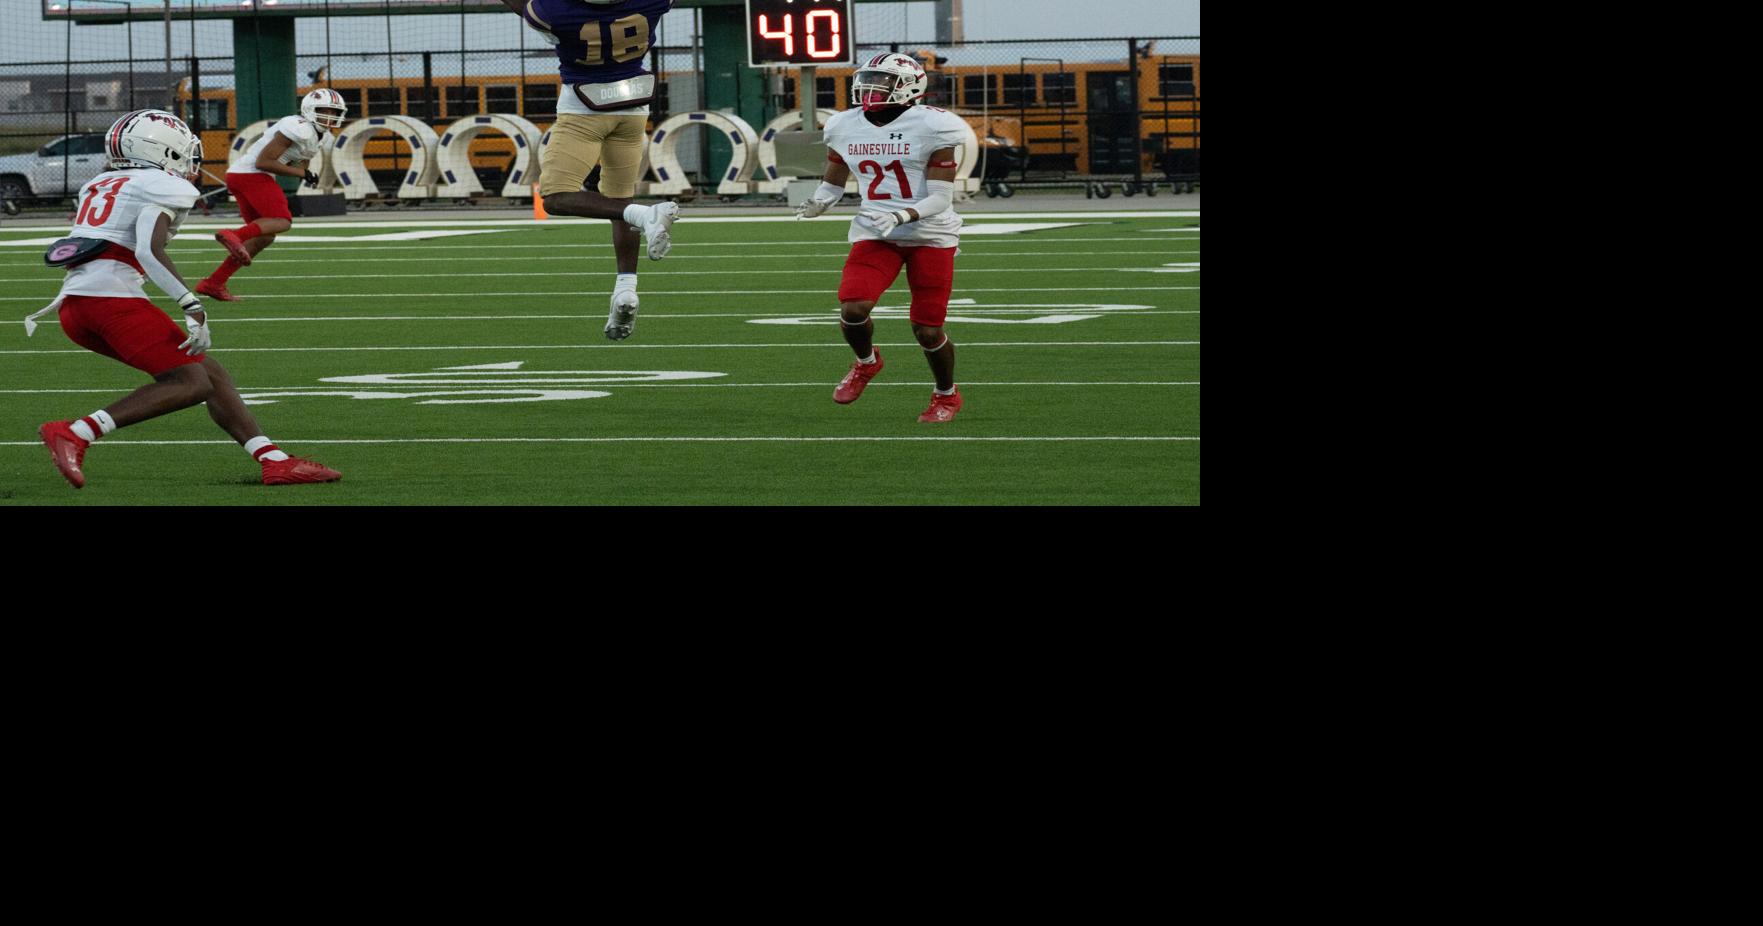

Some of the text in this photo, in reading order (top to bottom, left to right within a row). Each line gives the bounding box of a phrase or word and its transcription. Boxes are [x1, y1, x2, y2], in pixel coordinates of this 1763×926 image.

[575, 13, 650, 65] 18
[758, 9, 841, 58] 40
[600, 83, 644, 100] DOUAS
[847, 143, 911, 156] GAINESVILLE
[76, 176, 130, 228] 13
[858, 159, 913, 201] 21
